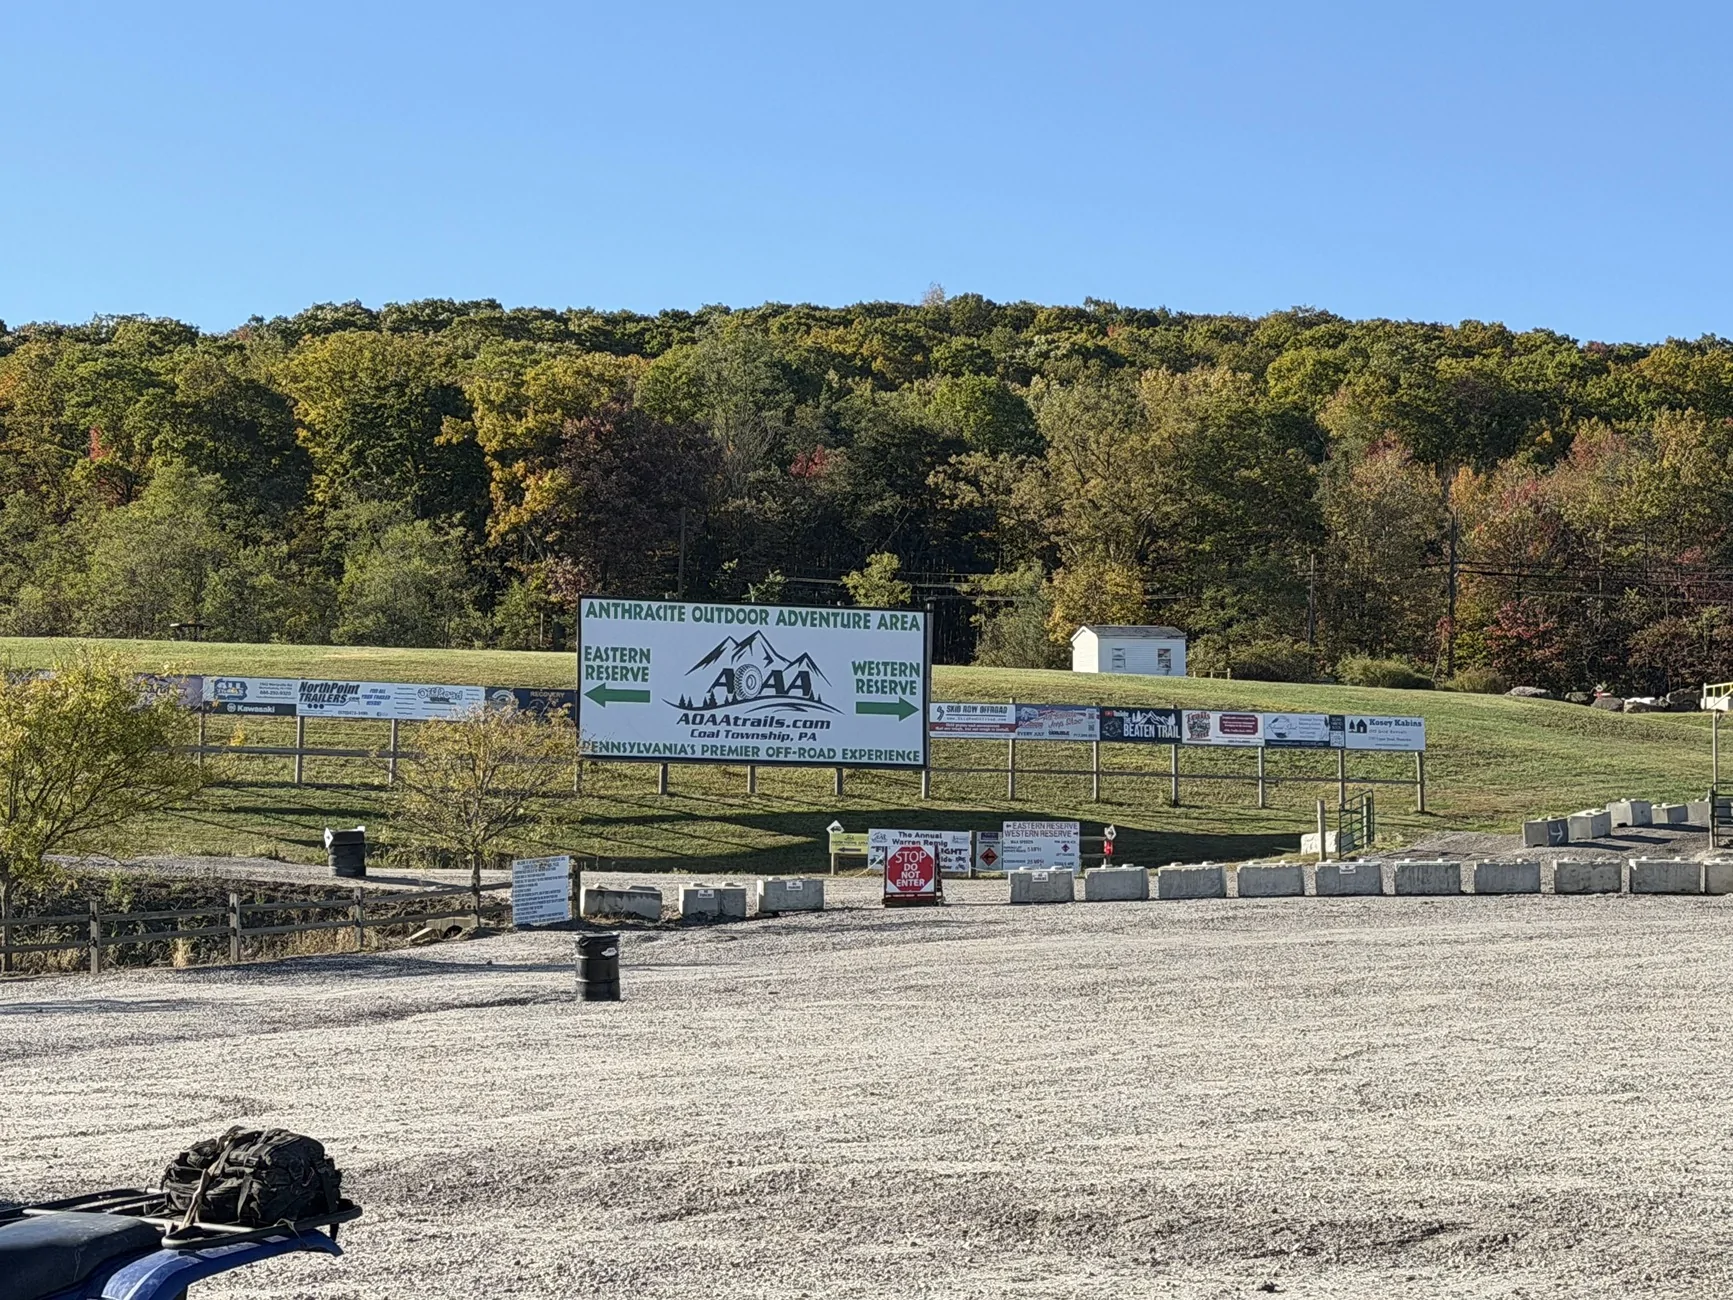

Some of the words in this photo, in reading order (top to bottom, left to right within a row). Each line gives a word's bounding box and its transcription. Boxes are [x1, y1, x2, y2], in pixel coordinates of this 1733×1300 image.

[585, 601, 686, 622] ANTHRACITE
[691, 606, 770, 626] OUTDOOR
[775, 609, 871, 630] ADVENTURE
[876, 613, 921, 632] AREA
[584, 646, 651, 664] EASTERN
[585, 665, 650, 682] RESERVE
[852, 661, 920, 678] WESTERN
[299, 682, 360, 695] NorthPoint
[855, 679, 917, 696] RESERVE
[237, 704, 276, 713] Kawasaki
[946, 705, 961, 713] SKID
[964, 705, 978, 713] ROW
[980, 706, 1008, 714] OFFROAD
[676, 713, 831, 730] AOAAtrails.com
[1369, 719, 1393, 728] Kosey
[1394, 719, 1422, 727] Kabins
[690, 729, 720, 739] Coal
[724, 730, 794, 742] Township,
[798, 732, 817, 742] PA
[1123, 723, 1155, 738] BEATEN
[1157, 725, 1181, 738] TRAIL
[581, 740, 696, 756] PENNSYLVANIA'S
[701, 744, 761, 758] PREMIER
[765, 747, 836, 760] OFF-ROAD
[842, 749, 920, 762] EXPERIENCE
[1012, 822, 1045, 830] EASTERN
[1046, 822, 1078, 830] RESERVE
[899, 831, 912, 839] The
[1004, 829, 1039, 838] WESTERN
[1040, 829, 1072, 838] RESERVE
[892, 838, 921, 846] Warren
[895, 851, 927, 864] STOP
[903, 863, 918, 871] DO
[901, 871, 920, 879] NOT
[896, 879, 925, 888] ENTER
